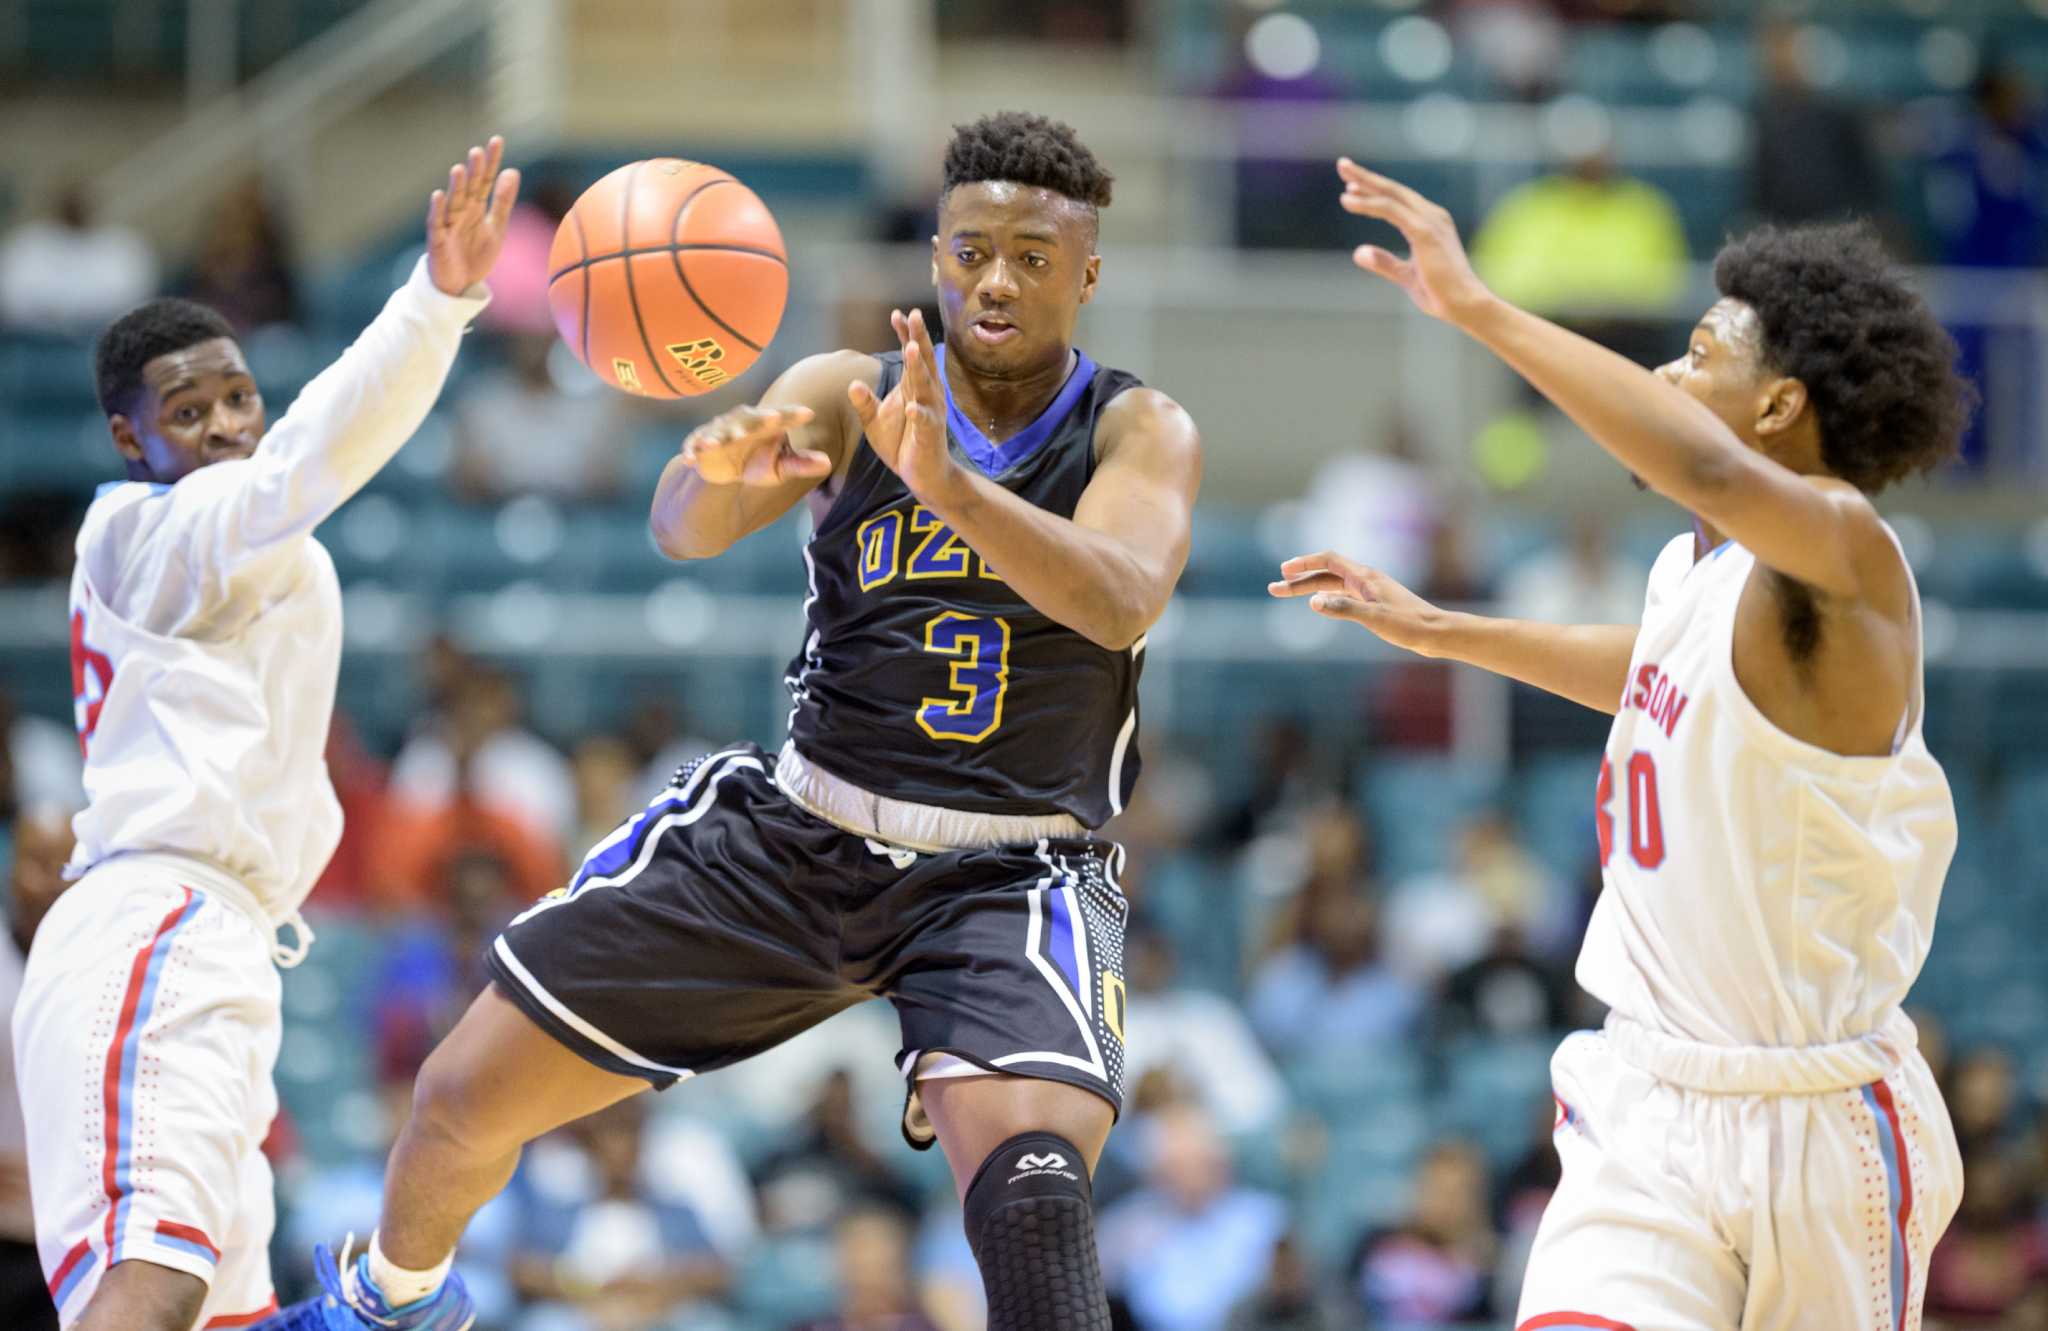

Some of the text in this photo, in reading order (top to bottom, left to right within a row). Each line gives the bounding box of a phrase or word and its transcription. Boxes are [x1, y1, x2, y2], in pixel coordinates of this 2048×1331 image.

[857, 504, 1002, 592] OZ
[915, 610, 1011, 743] 3
[1624, 664, 1688, 738] SON
